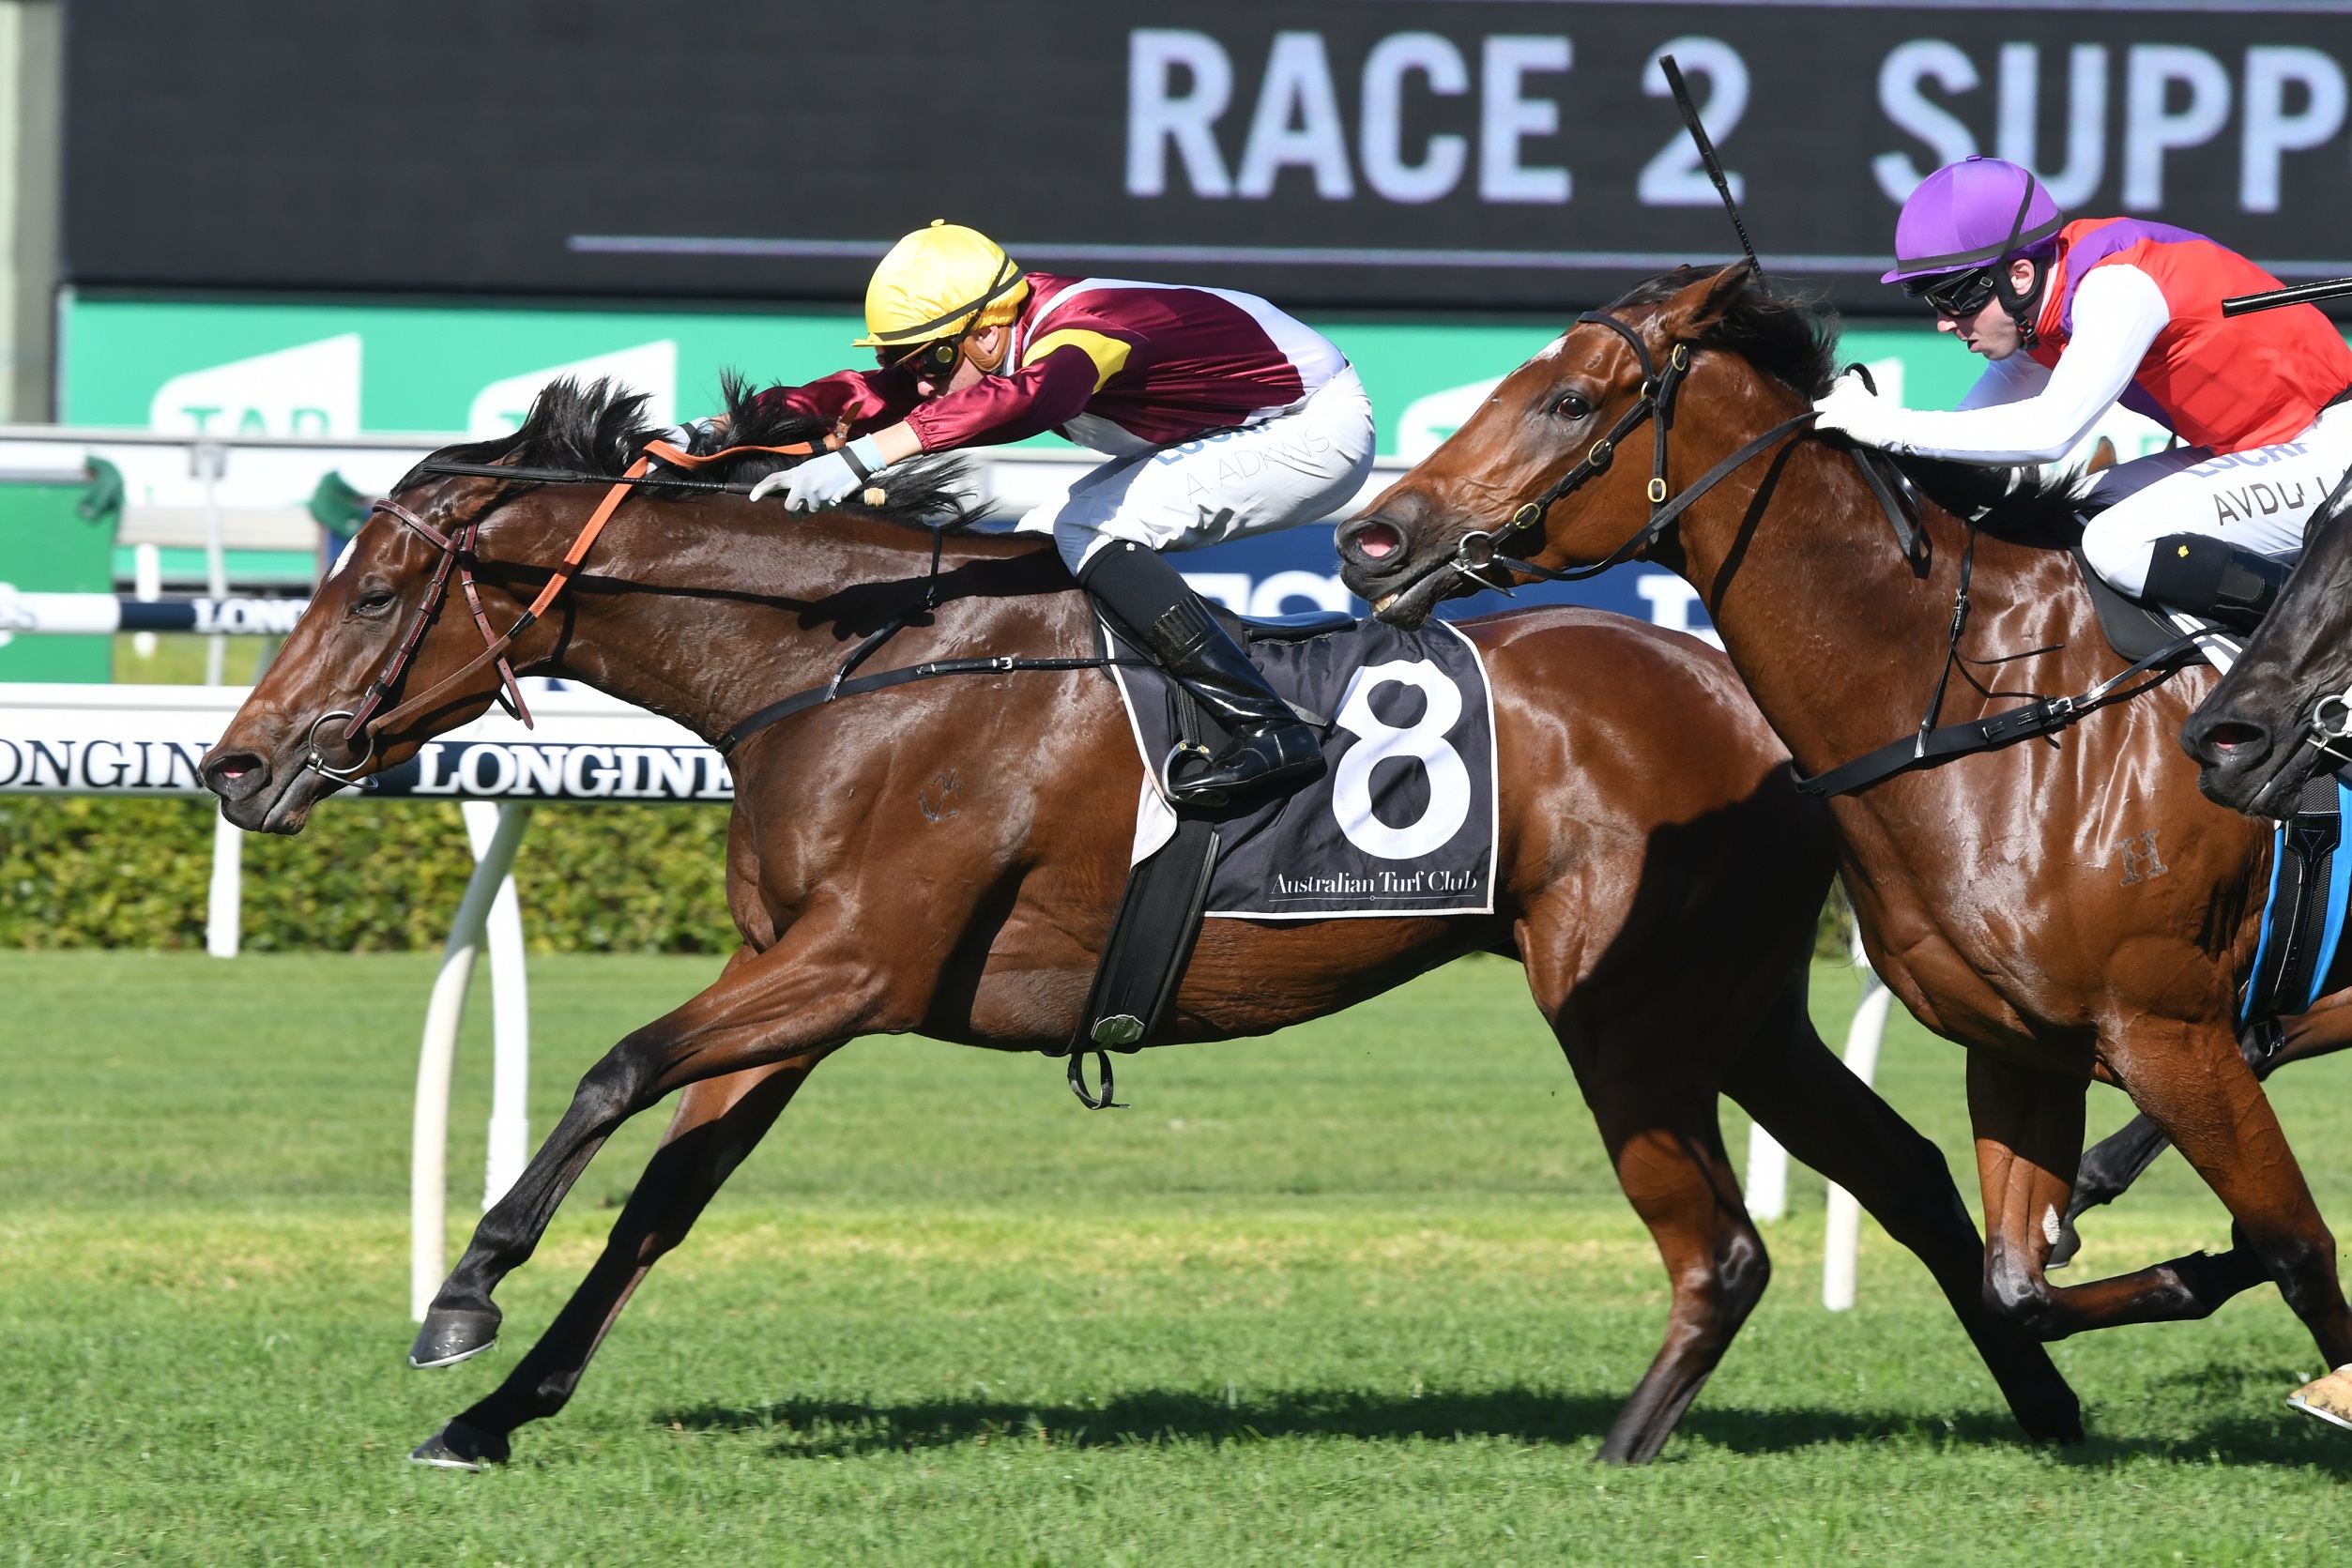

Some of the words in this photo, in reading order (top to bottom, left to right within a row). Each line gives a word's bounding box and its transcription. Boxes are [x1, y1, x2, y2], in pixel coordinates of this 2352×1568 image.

[1126, 27, 1574, 205] RACE
[1637, 36, 1750, 206] 2
[1872, 38, 2346, 213] SUPP
[1332, 658, 1473, 860] 8
[1271, 872, 1375, 895] Australian
[1379, 870, 1426, 892] Turf
[1428, 869, 1478, 891] Club
